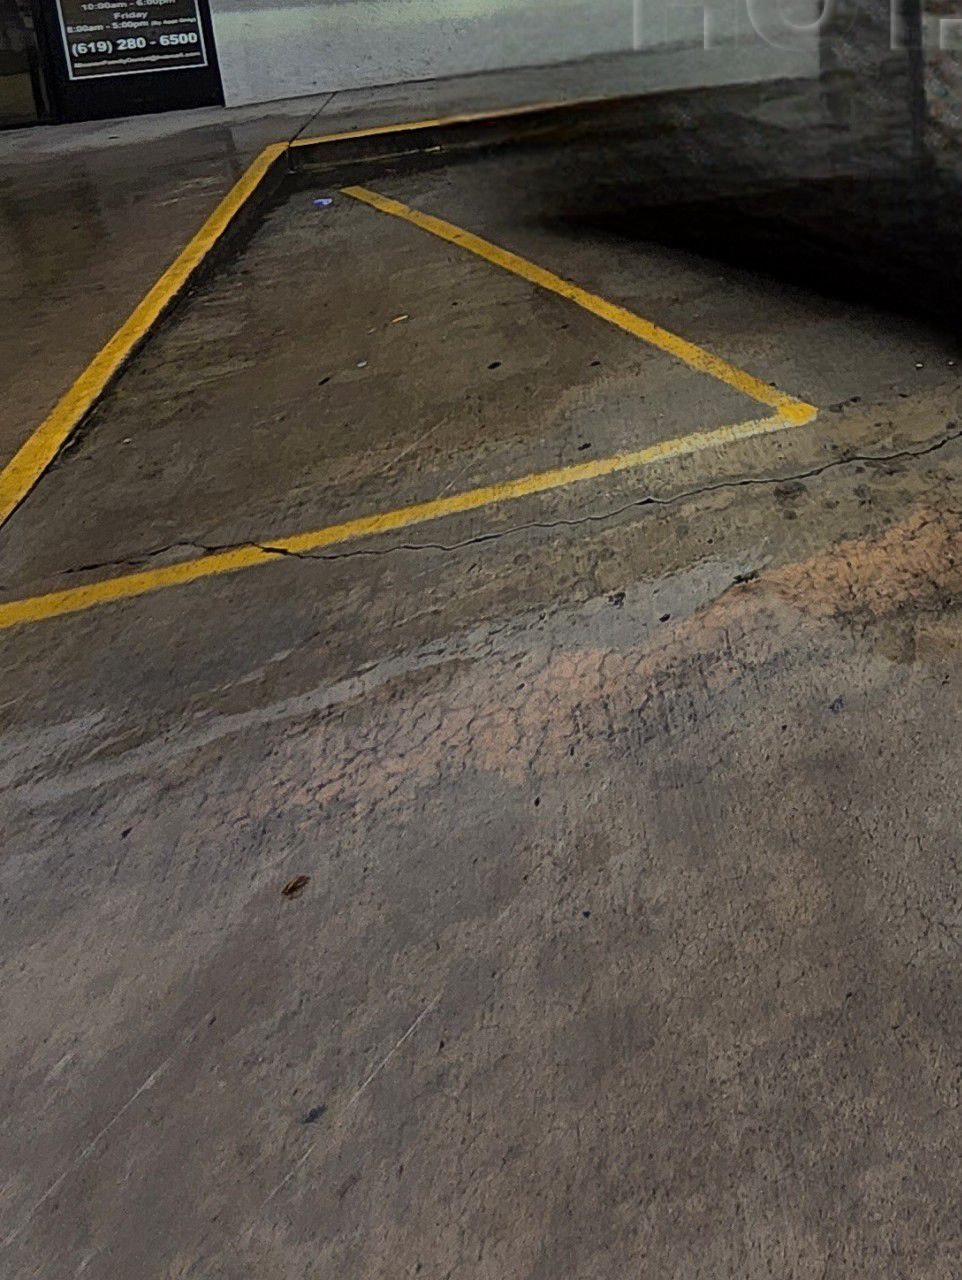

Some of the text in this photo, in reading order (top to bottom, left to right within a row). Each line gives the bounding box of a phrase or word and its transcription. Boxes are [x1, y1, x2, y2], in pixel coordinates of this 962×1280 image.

[113, 12, 148, 20] Friday
[72, 41, 113, 57] (619)
[116, 37, 146, 51] 280
[159, 32, 198, 47] 6500
